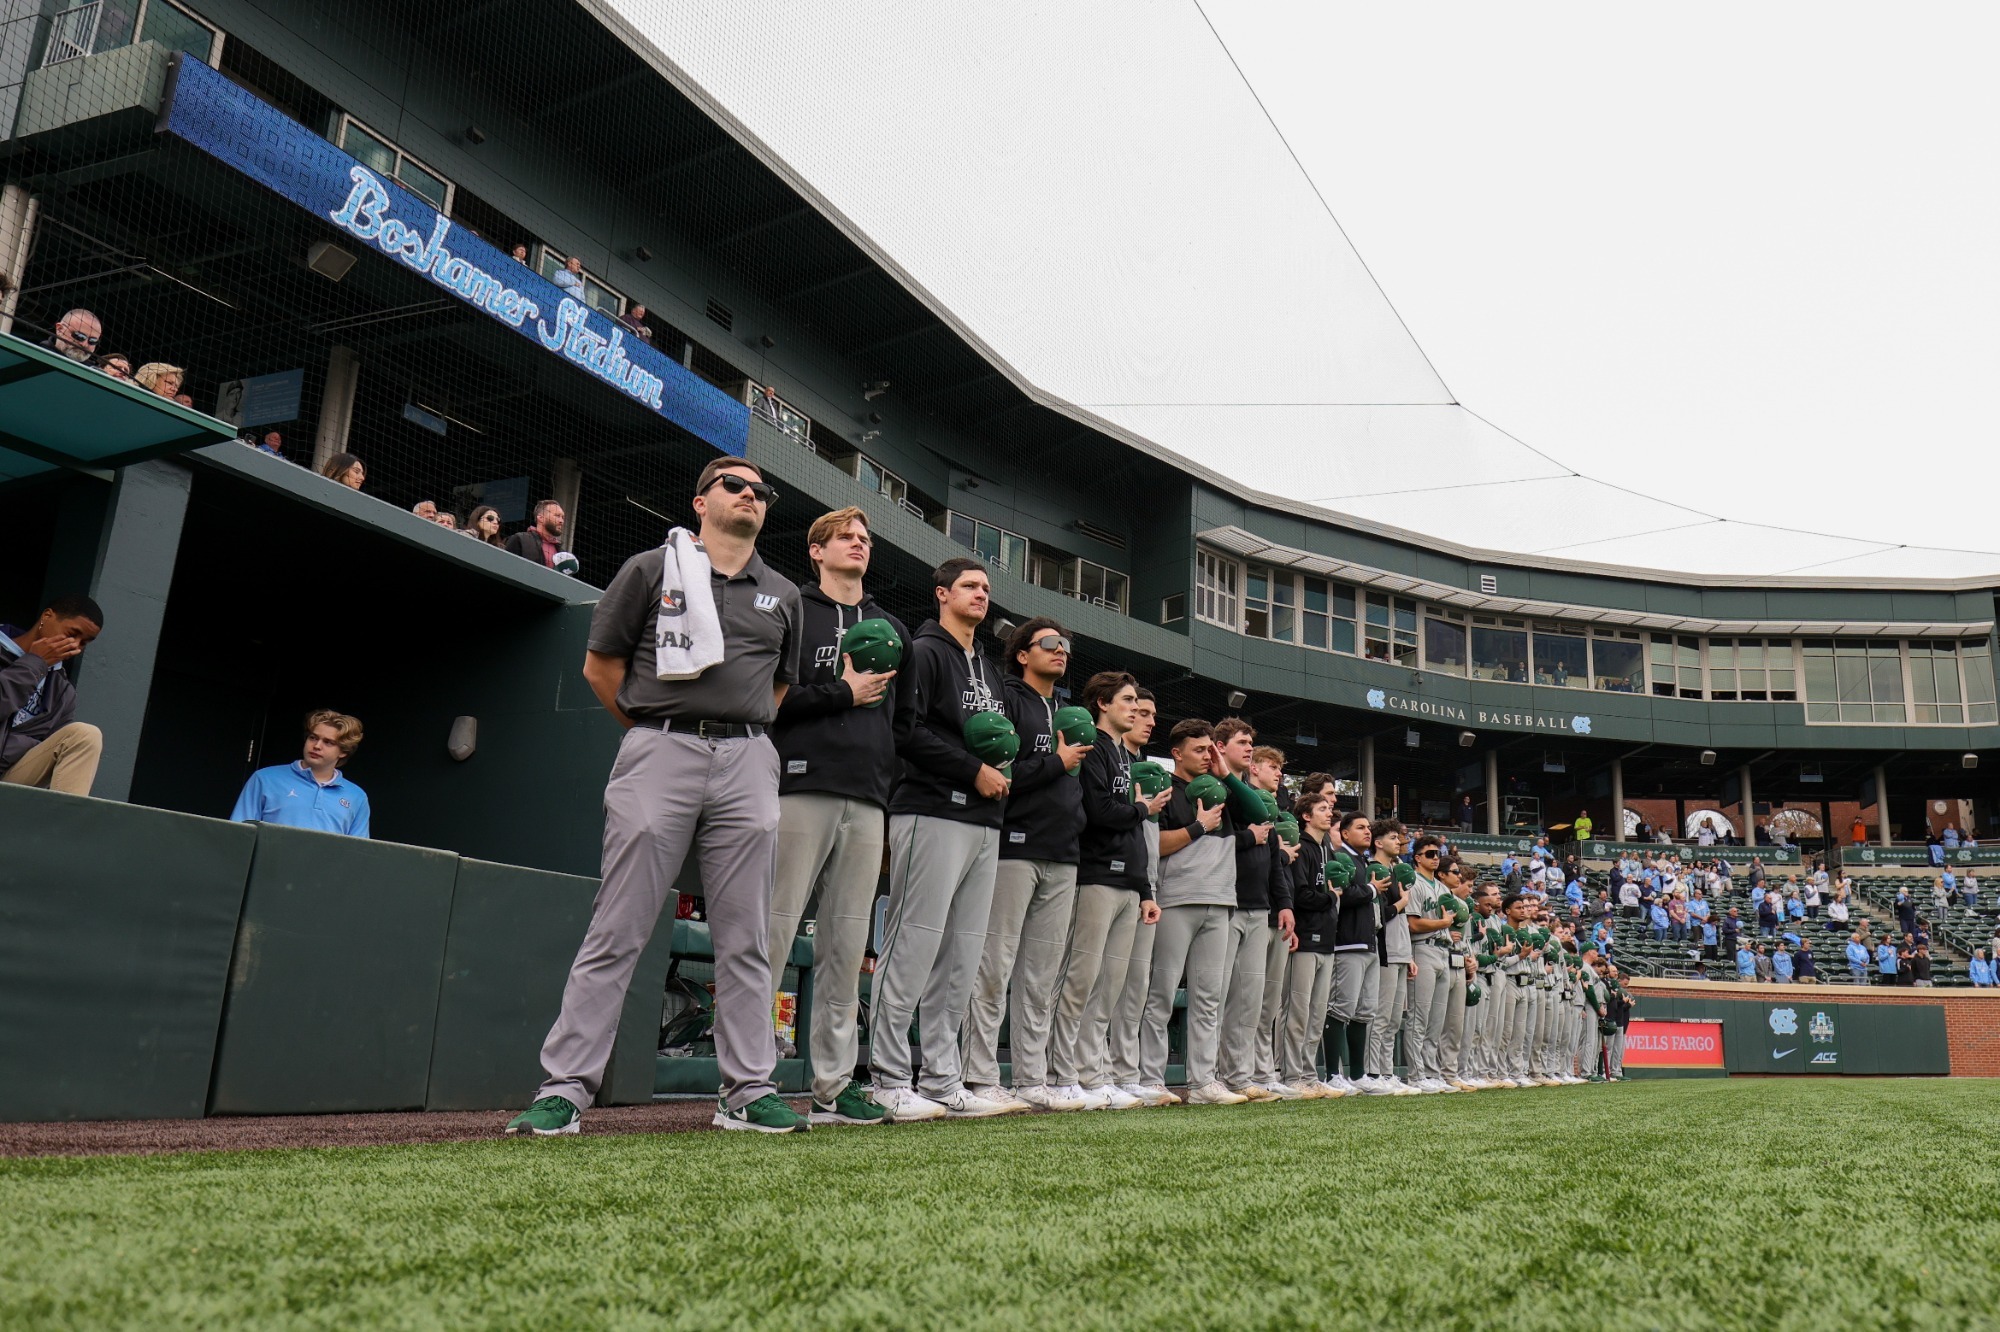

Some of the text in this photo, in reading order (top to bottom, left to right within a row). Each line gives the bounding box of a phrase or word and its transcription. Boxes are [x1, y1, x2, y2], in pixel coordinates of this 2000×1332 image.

[330, 165, 663, 409] Boshamer Stadium
[1389, 696, 1568, 729] CAROLINA BASEBALL
[1624, 1035, 1715, 1052] WELLS FARGO
[1812, 1052, 1838, 1061] ACC
